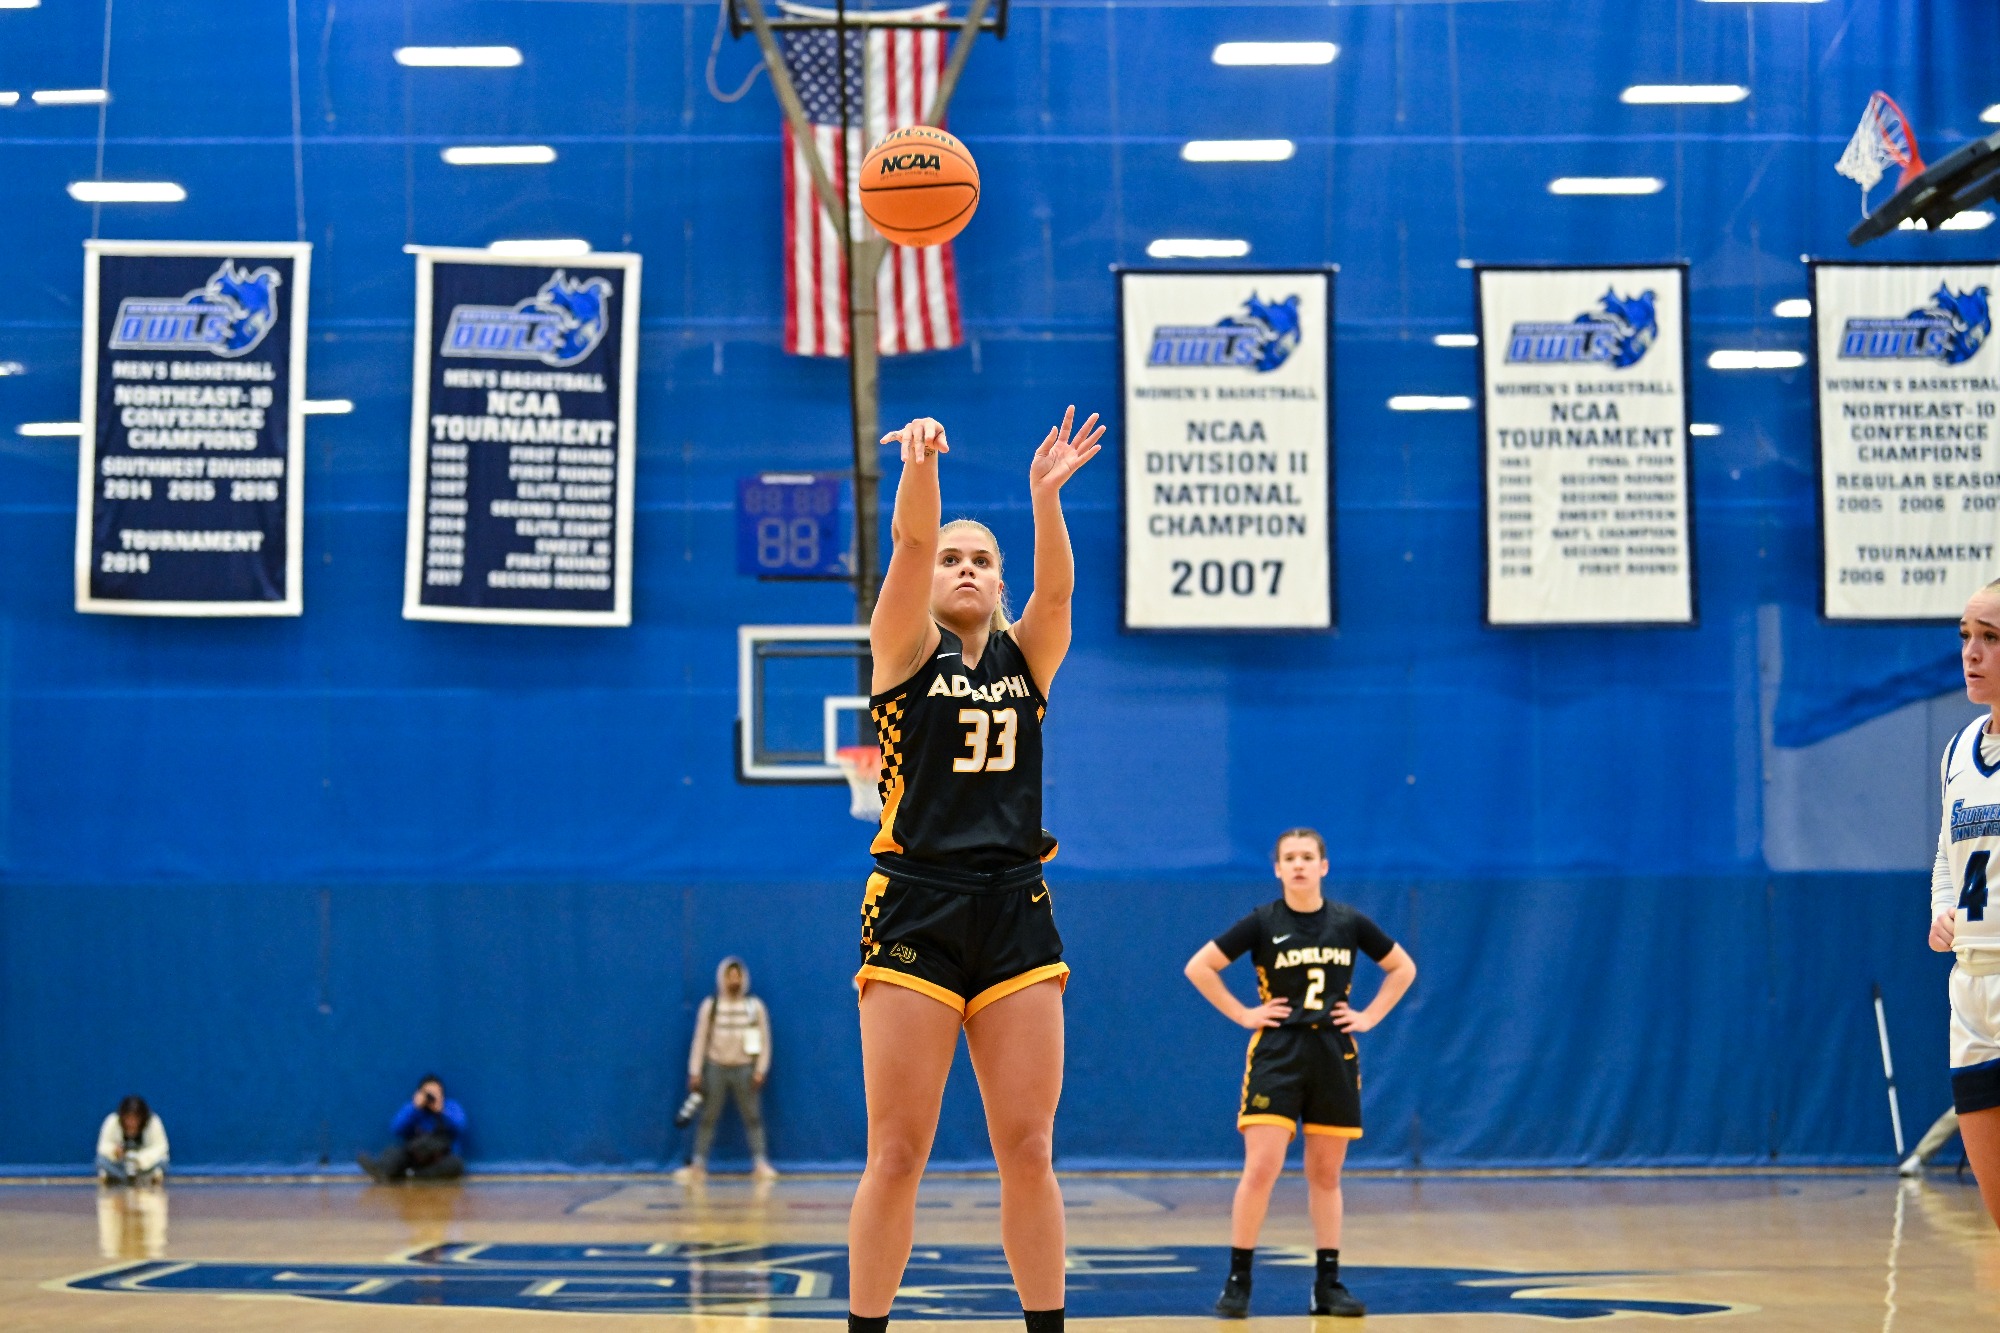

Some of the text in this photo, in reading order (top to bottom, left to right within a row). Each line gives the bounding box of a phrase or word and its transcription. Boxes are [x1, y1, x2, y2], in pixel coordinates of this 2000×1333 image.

[880, 153, 940, 174] NCAA
[119, 315, 229, 343] OWLS
[452, 322, 558, 351] OWLS
[1150, 336, 1255, 365] OWLS
[1507, 332, 1614, 363] OWLS
[1844, 331, 1947, 358] OWLS
[112, 360, 276, 381] MEN'S BASKETBALL
[443, 368, 607, 393] MEN'S BASKETBALL
[1133, 386, 1318, 401] WOMEN'S BASKETBALL
[1495, 381, 1676, 396] WOMEN'S BASKETBALL
[1826, 376, 1903, 392] WOMEN'S
[113, 384, 273, 408] NORTHEAST-10
[486, 390, 561, 418] NCAA
[120, 406, 265, 429] CONFERENCE
[1550, 401, 1620, 422] NCAA
[1843, 402, 1996, 420] NORTHEAST-10
[127, 428, 257, 450] CHAMPIONS
[431, 414, 616, 446] TOURNAMENT
[1186, 419, 1267, 444] NCAA
[1497, 427, 1676, 449] TOURNAMENT
[1851, 423, 1989, 441] CONFERENCE
[1145, 451, 1309, 475] DIVISION II
[1857, 445, 1982, 462] CHAMPIONS
[206, 457, 284, 478] DIVISION
[103, 478, 152, 500] 2014
[1836, 472, 1926, 489] REGULAR
[1153, 483, 1302, 506] NATIONAL
[1148, 513, 1307, 537] CHAMPION
[119, 529, 265, 552] TOURNAMENT
[101, 551, 150, 574] 2014
[1857, 545, 1994, 561] TOURNAMENT
[1170, 558, 1285, 597] 2007
[1902, 568, 1948, 584] 2007
[927, 673, 1030, 703] ADELPHI
[953, 707, 1018, 773] 33
[1957, 850, 1990, 922] 4
[1274, 947, 1351, 970] ADELPHI
[1303, 967, 1326, 1011] 2
